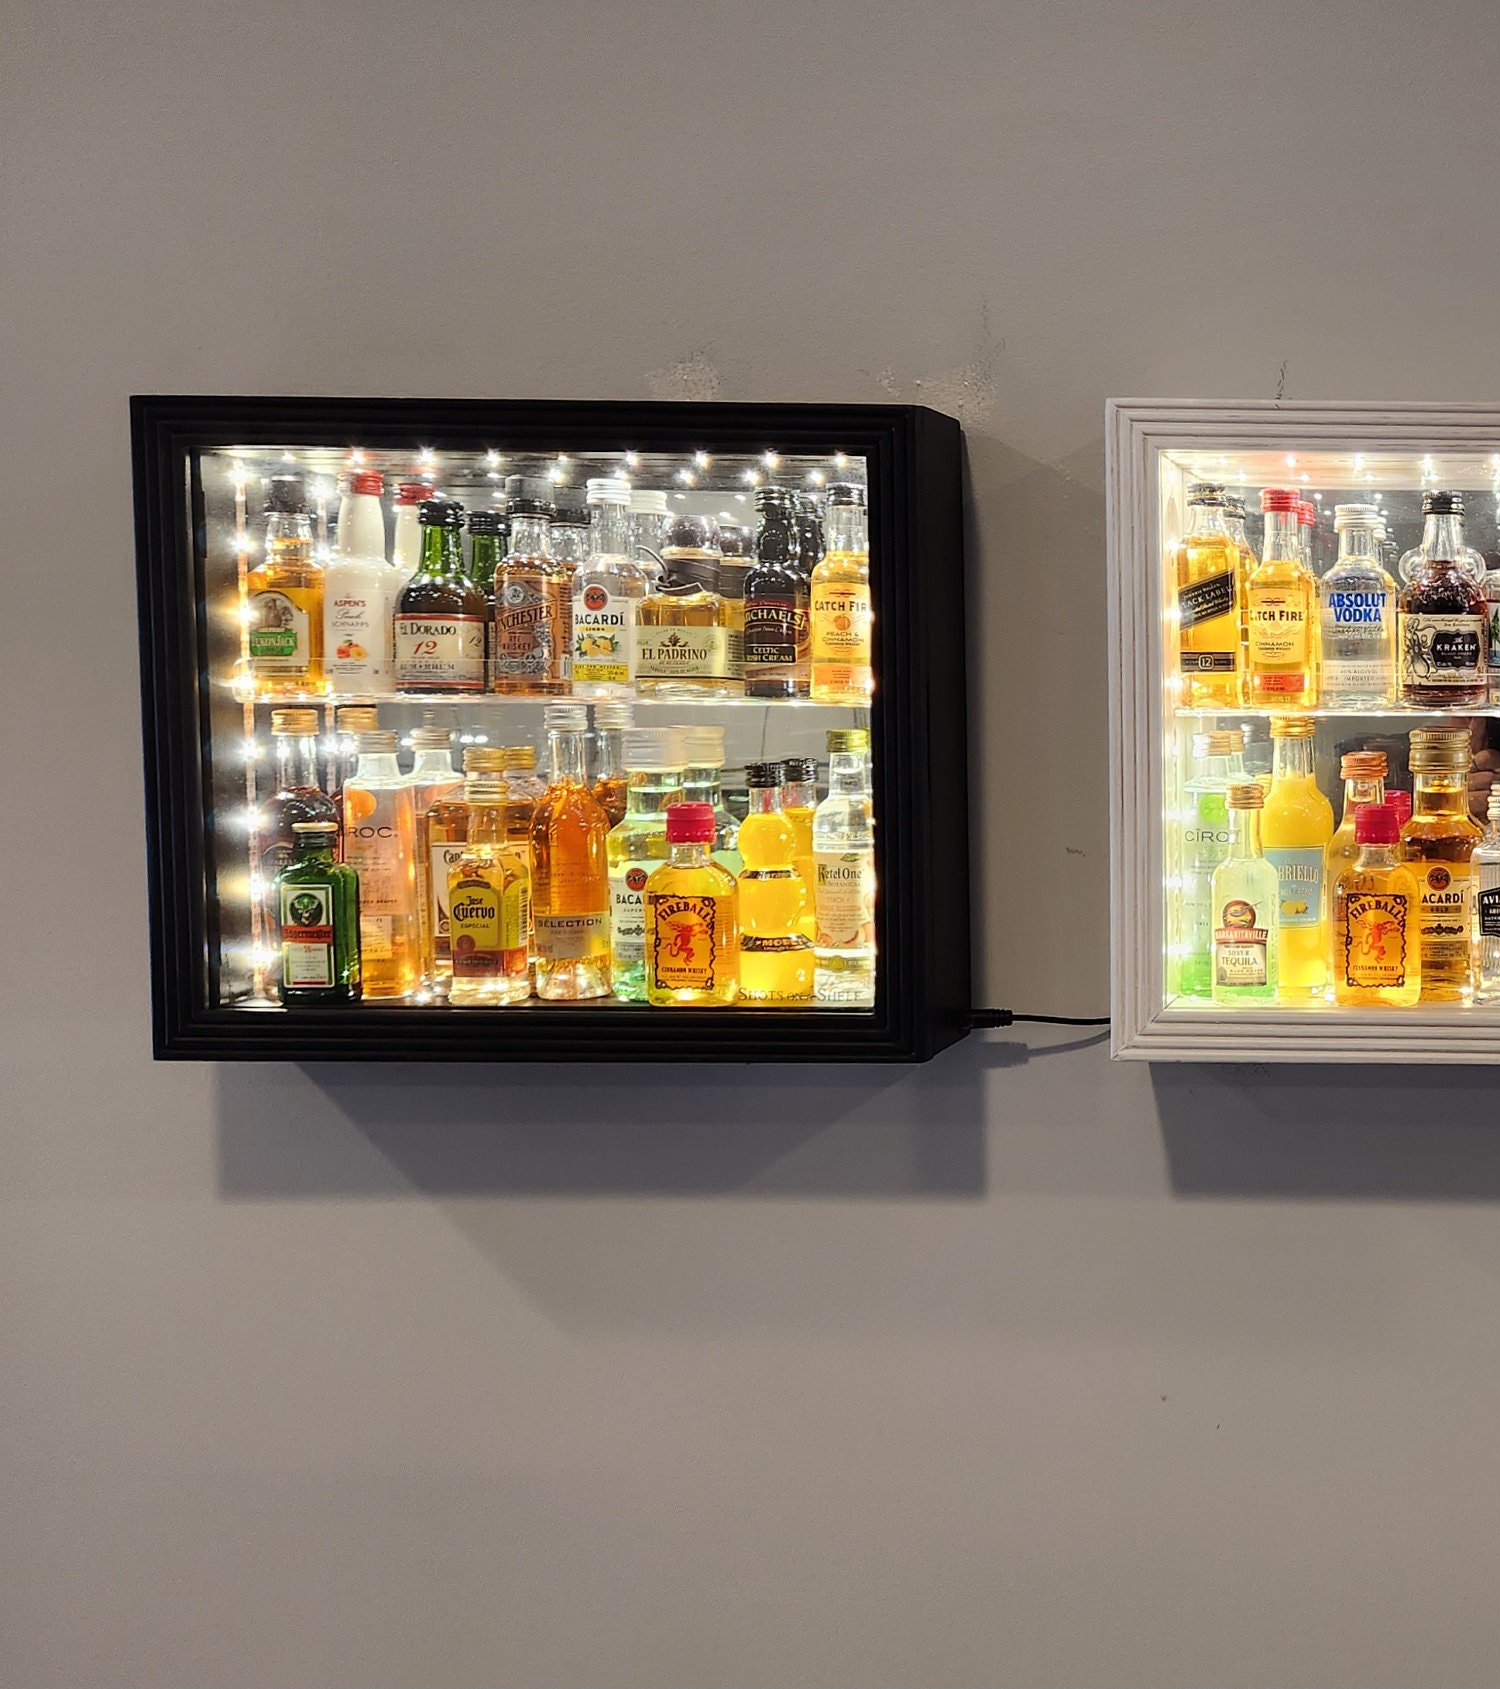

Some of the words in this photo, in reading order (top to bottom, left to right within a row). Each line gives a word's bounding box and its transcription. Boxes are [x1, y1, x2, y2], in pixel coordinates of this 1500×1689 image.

[1181, 595, 1204, 609] LACK
[1205, 585, 1231, 599] LABEL
[1329, 593, 1386, 608] ABSOLUT
[815, 601, 845, 611] CATCH
[849, 601, 867, 611] FIR
[575, 612, 624, 625] BACARDÍ
[1250, 611, 1276, 621] CTCH
[1279, 610, 1304, 621] FIRE
[1334, 609, 1382, 622] VODKA
[411, 622, 456, 636] DORADO
[413, 641, 437, 655] 12
[642, 649, 655, 660] EL
[658, 649, 707, 660] PADRINO
[1202, 658, 1211, 666] 12
[346, 826, 392, 838] ROC
[1185, 828, 1229, 843] CÎRO
[817, 864, 841, 884] Ketel
[842, 868, 862, 879] One
[1279, 863, 1320, 884] BRIELLO
[616, 893, 645, 904] BACA
[1421, 889, 1464, 904] ACARDÍ
[453, 902, 495, 922] Cuervo
[658, 901, 711, 922] FIREBALL
[1350, 900, 1403, 920] FIREBALL
[1216, 928, 1268, 940] MARGARITAVILLE
[1221, 956, 1258, 967] TEQUILA
[817, 988, 862, 1001] SHELF
